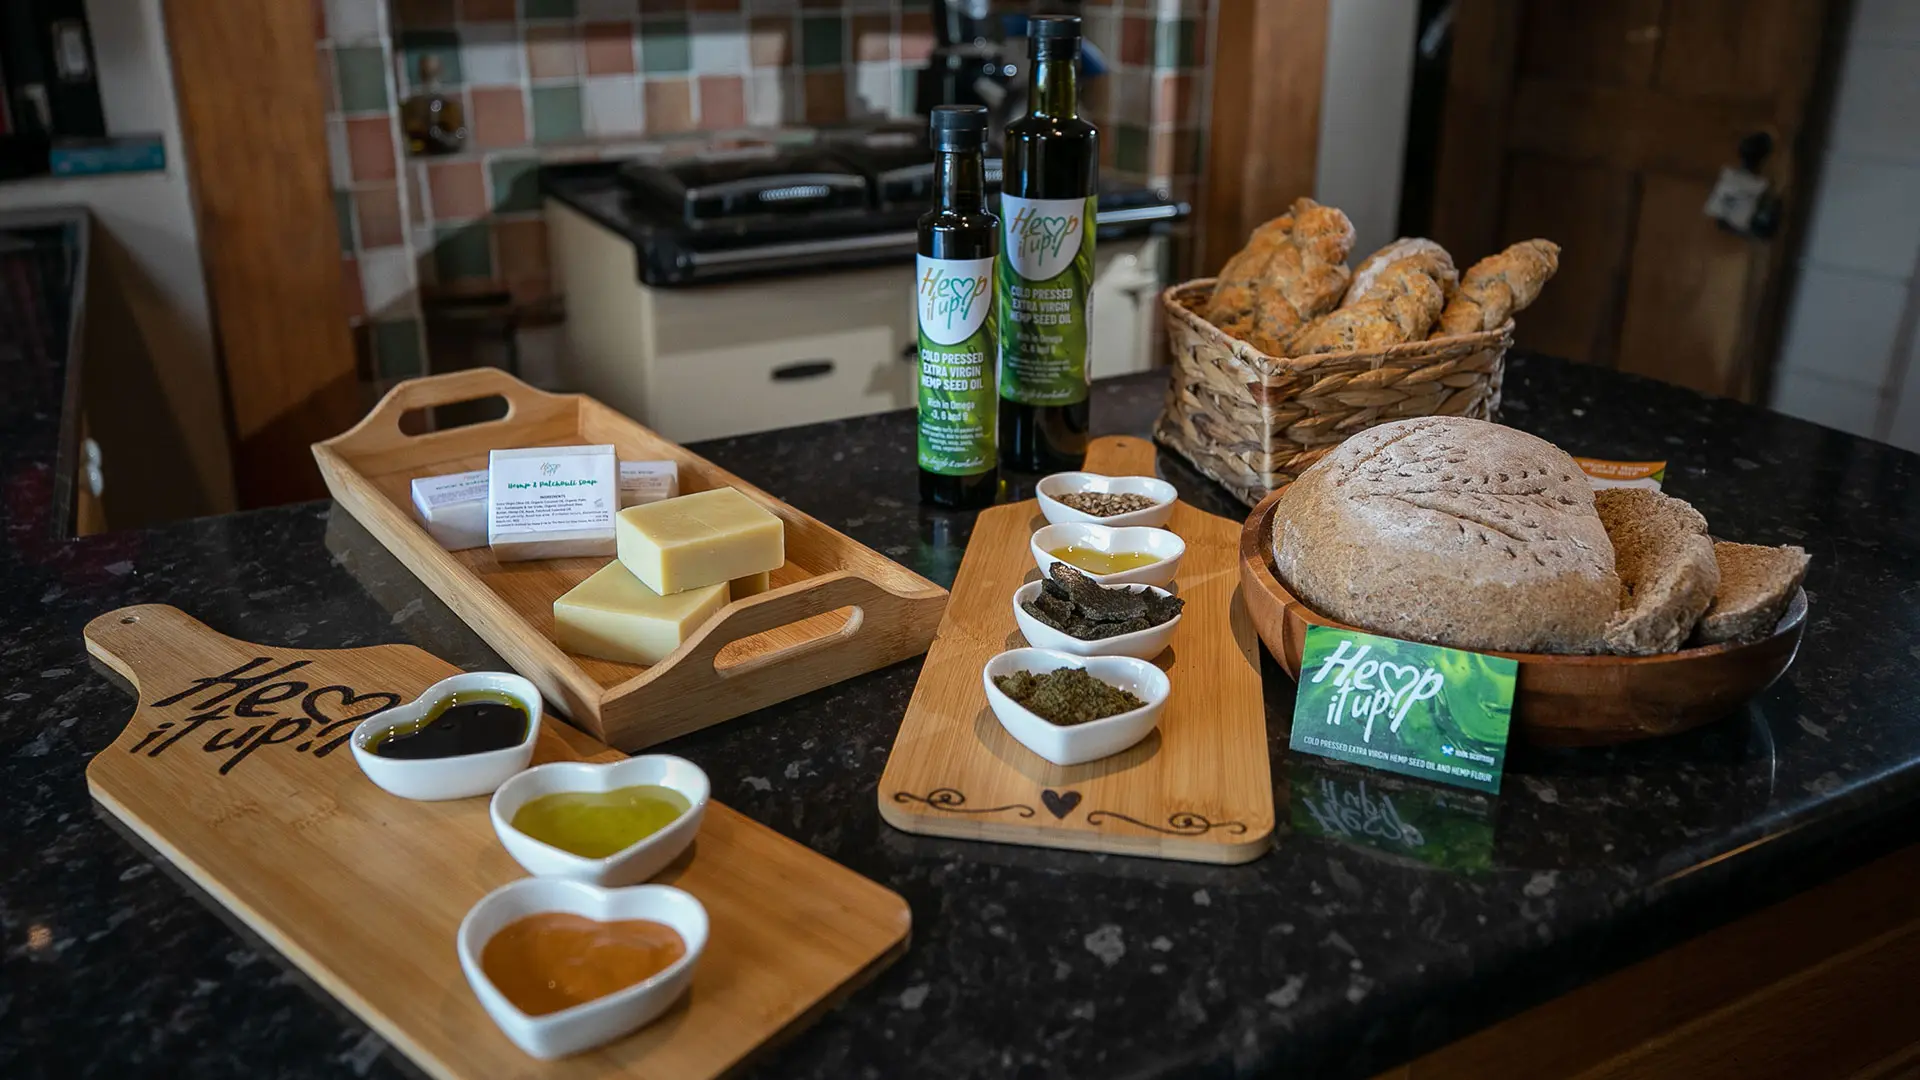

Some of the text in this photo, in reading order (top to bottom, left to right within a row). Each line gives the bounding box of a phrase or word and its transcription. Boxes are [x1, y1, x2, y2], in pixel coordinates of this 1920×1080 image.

[1011, 285, 1073, 300] COLD PRESSED
[1012, 298, 1071, 313] EXTRA VIRGIN
[1033, 313, 1058, 325] SEED
[1059, 313, 1072, 325] OIL
[922, 349, 984, 365] COLD PRESSED
[923, 362, 982, 378] EXTRA VIRGIN
[921, 375, 984, 391] HEMP SEED OIL
[927, 397, 976, 411] Rich in Omega
[947, 411, 962, 421] and
[507, 482, 531, 490] Hemp
[540, 479, 577, 488] Patchouli
[1303, 736, 1493, 783] COLD PRESSED EXTRA VIRGIN HEMP SEED OIL AND HEMP FLOUR
